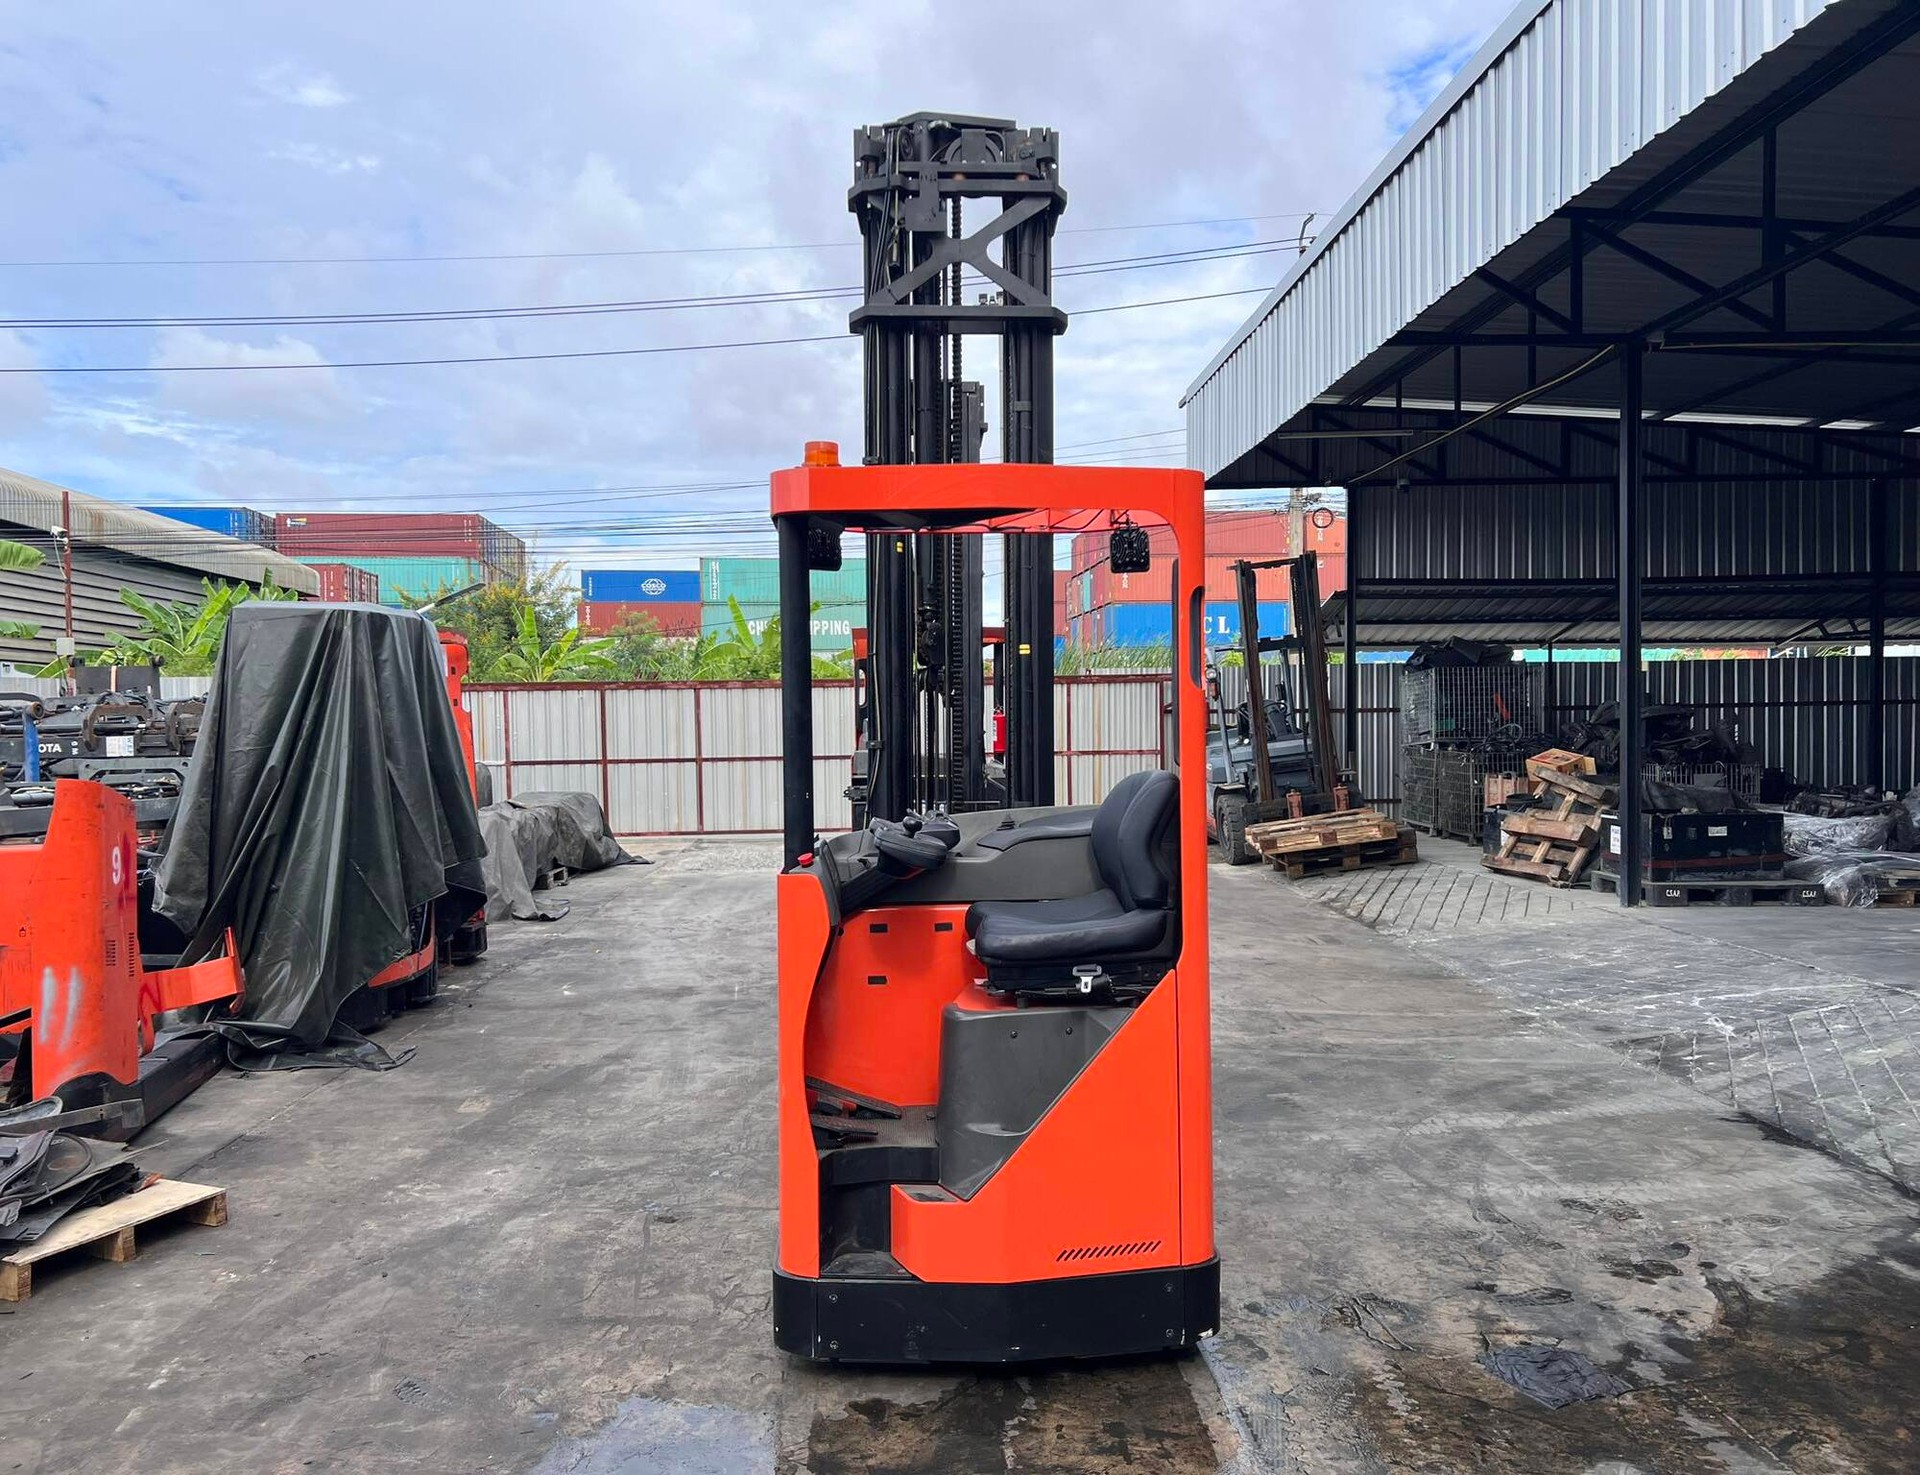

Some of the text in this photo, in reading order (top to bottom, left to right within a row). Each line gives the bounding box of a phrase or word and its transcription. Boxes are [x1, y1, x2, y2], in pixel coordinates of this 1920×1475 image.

[810, 620, 850, 635] IPPING
[39, 743, 62, 753] OTA
[112, 846, 121, 884] 9
